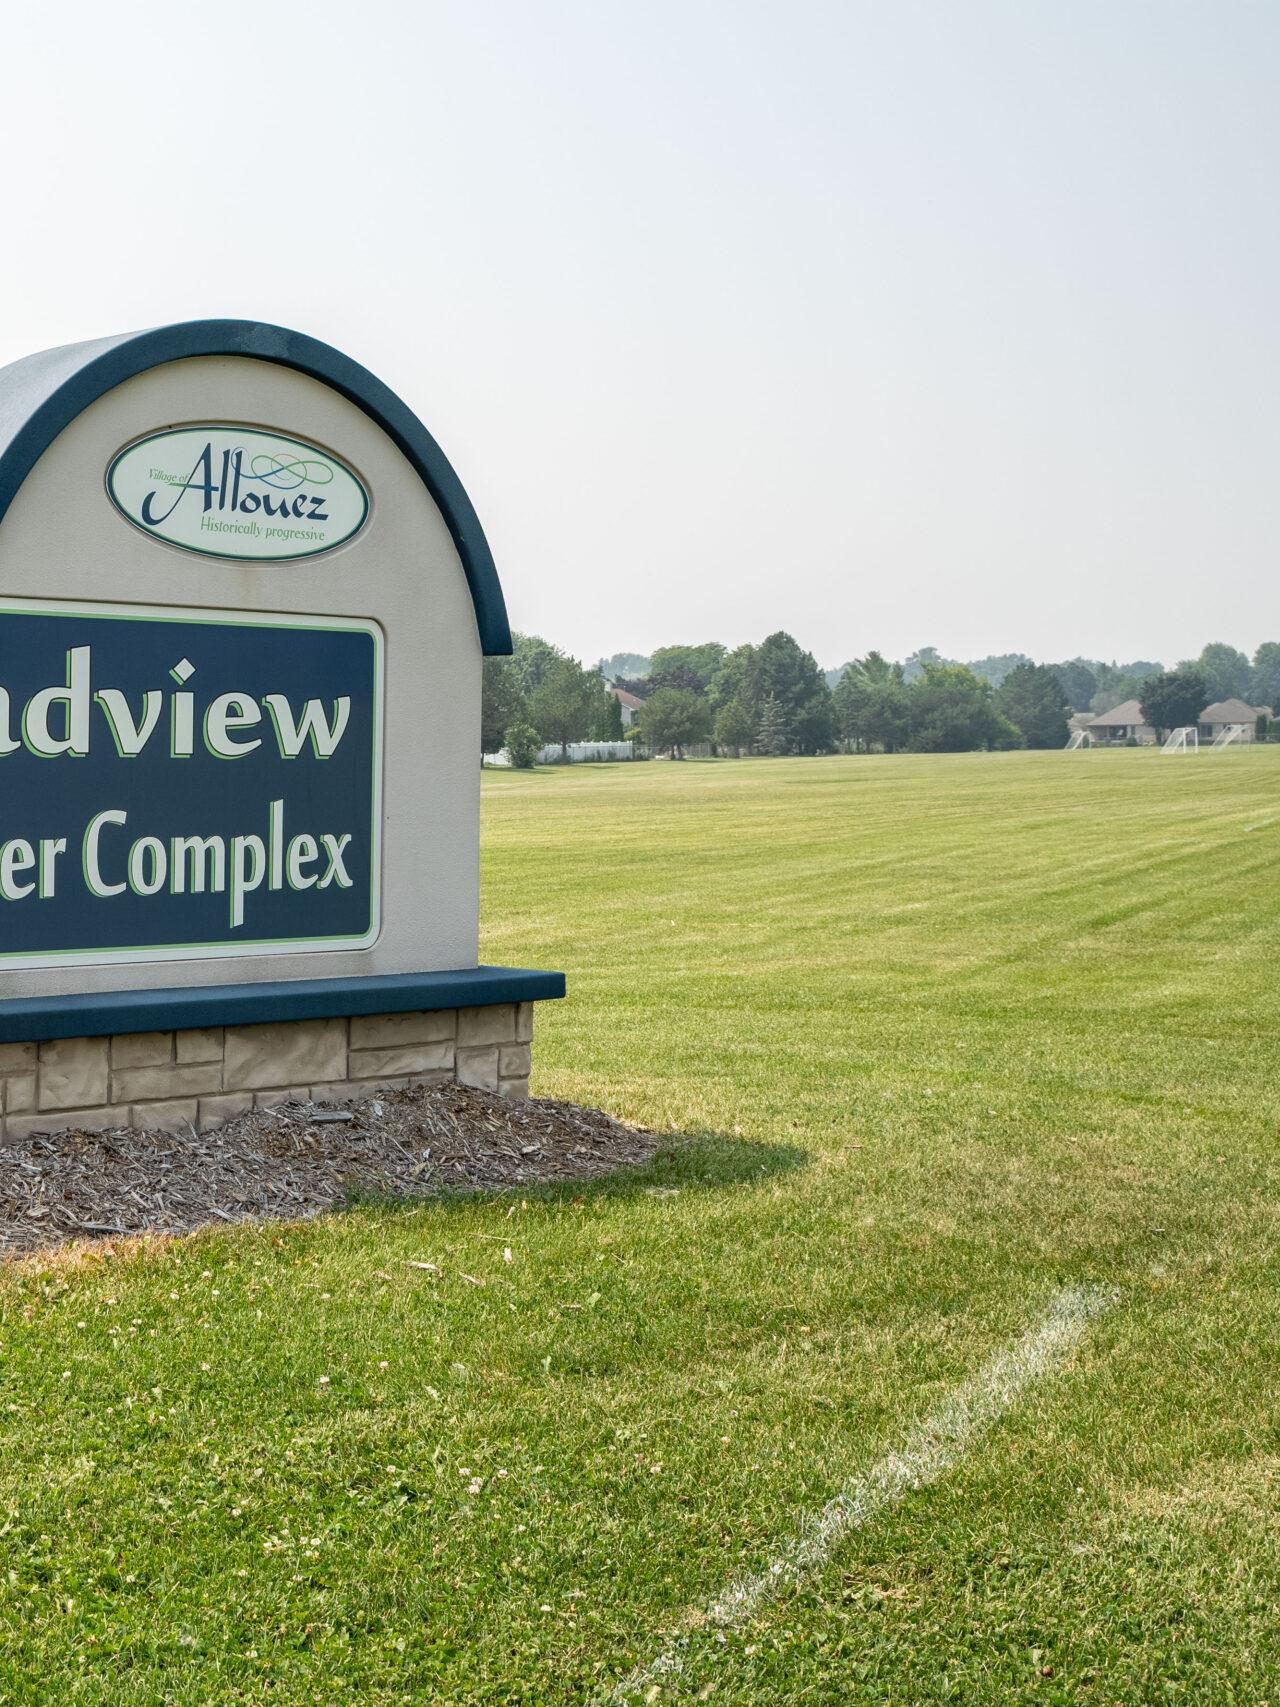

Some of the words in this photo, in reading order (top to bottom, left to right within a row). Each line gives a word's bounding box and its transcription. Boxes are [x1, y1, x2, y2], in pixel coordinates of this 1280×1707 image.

[141, 442, 329, 525] Allouez
[149, 468, 177, 483] Village
[179, 473, 190, 483] of
[200, 516, 264, 538] Historically
[265, 526, 326, 542] progressive
[82, 799, 353, 928] Complex
